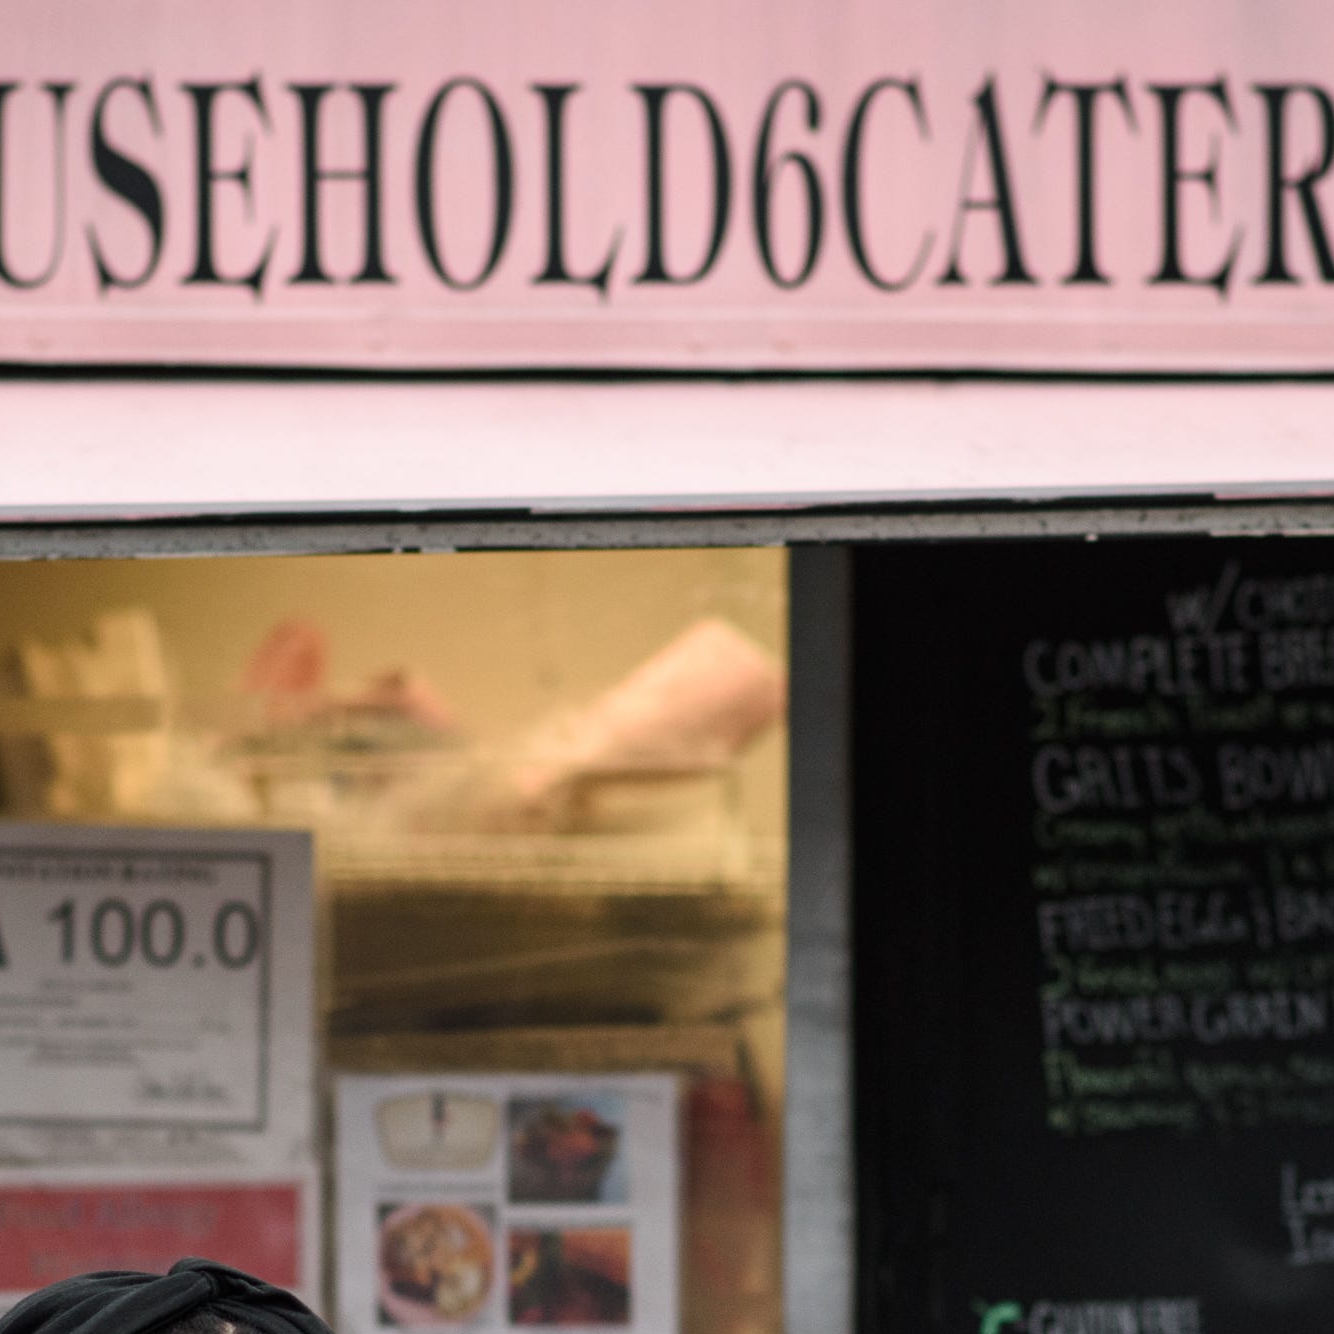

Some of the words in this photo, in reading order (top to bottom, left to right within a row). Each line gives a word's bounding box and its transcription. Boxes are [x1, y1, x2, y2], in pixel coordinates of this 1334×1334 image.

[1027, 635, 1249, 694] COMPLETE
[1036, 746, 1199, 812] GRITS
[48, 898, 259, 970] 100.0
[1046, 993, 1186, 1050] POWER
